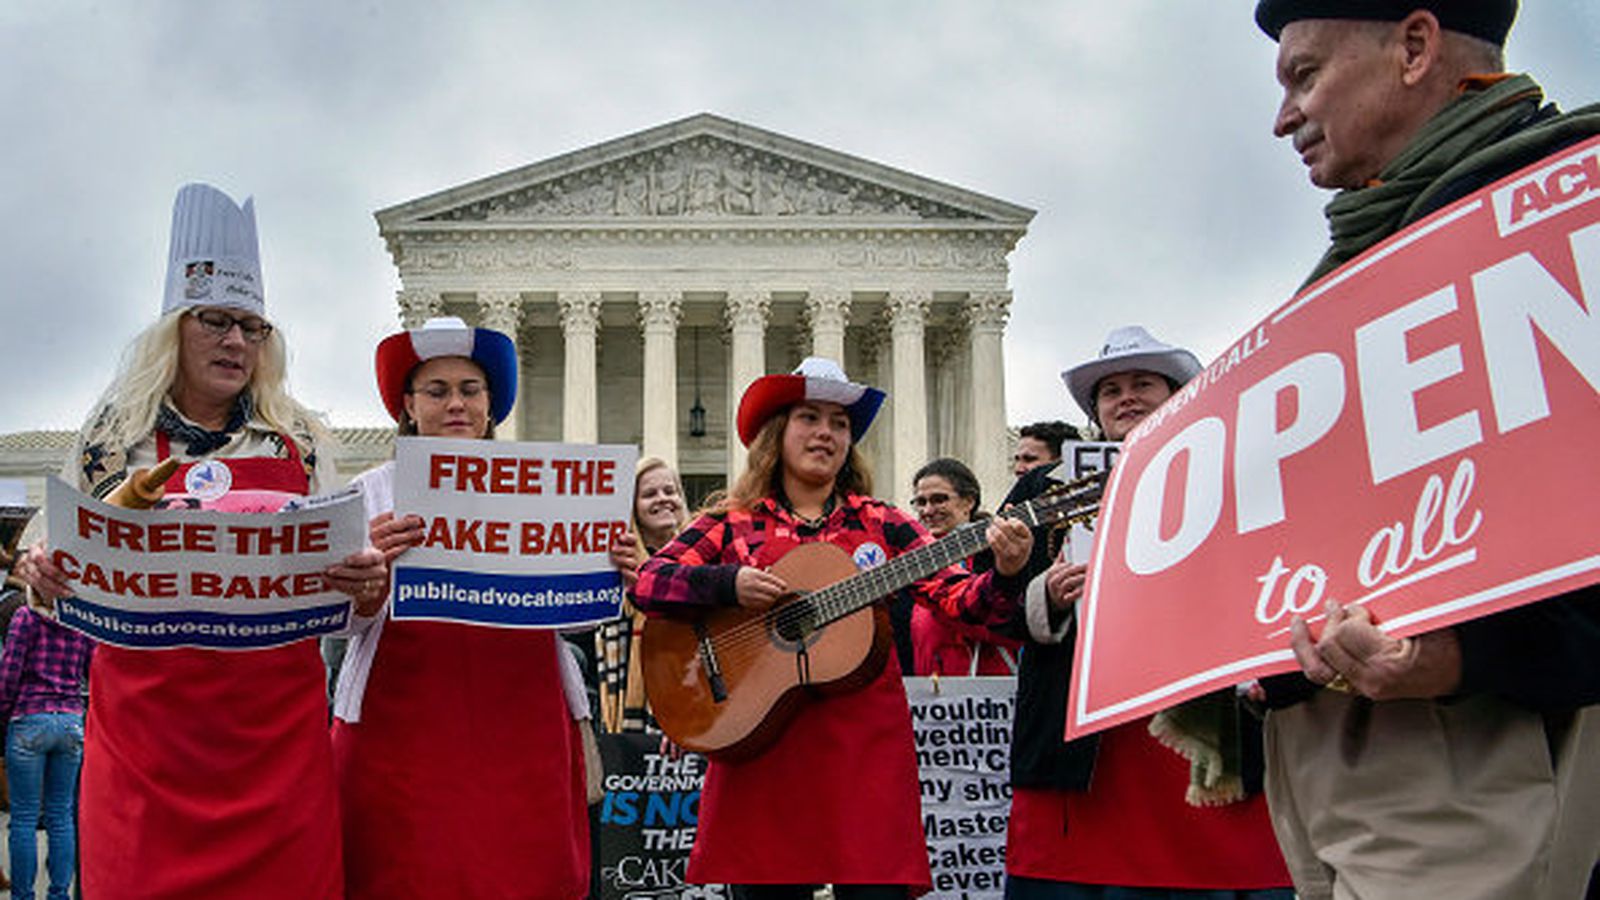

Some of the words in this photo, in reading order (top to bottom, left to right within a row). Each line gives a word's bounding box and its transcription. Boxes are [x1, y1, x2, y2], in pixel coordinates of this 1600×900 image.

[1125, 221, 1600, 575] OPEN
[428, 454, 544, 495] FREE
[551, 459, 616, 496] THE
[77, 505, 217, 554] FREE
[227, 520, 331, 556] THE
[418, 516, 512, 555] AKE
[1255, 555, 1328, 624] to
[1357, 457, 1483, 588] all
[52, 550, 179, 598] CAKE
[190, 571, 333, 600] BAKE
[398, 581, 622, 608] publicadvocateusa.org
[61, 602, 346, 637] publicadvocateusa.org
[910, 697, 1014, 721] wouldn'
[913, 721, 1010, 747] weddin
[643, 753, 700, 776] THE
[605, 774, 706, 791] GOVERNM
[963, 778, 1013, 801] sho
[600, 791, 640, 826] IS
[643, 790, 702, 827] NO
[924, 811, 1010, 837] Maste
[641, 827, 698, 850] THE
[606, 855, 691, 889] CAK
